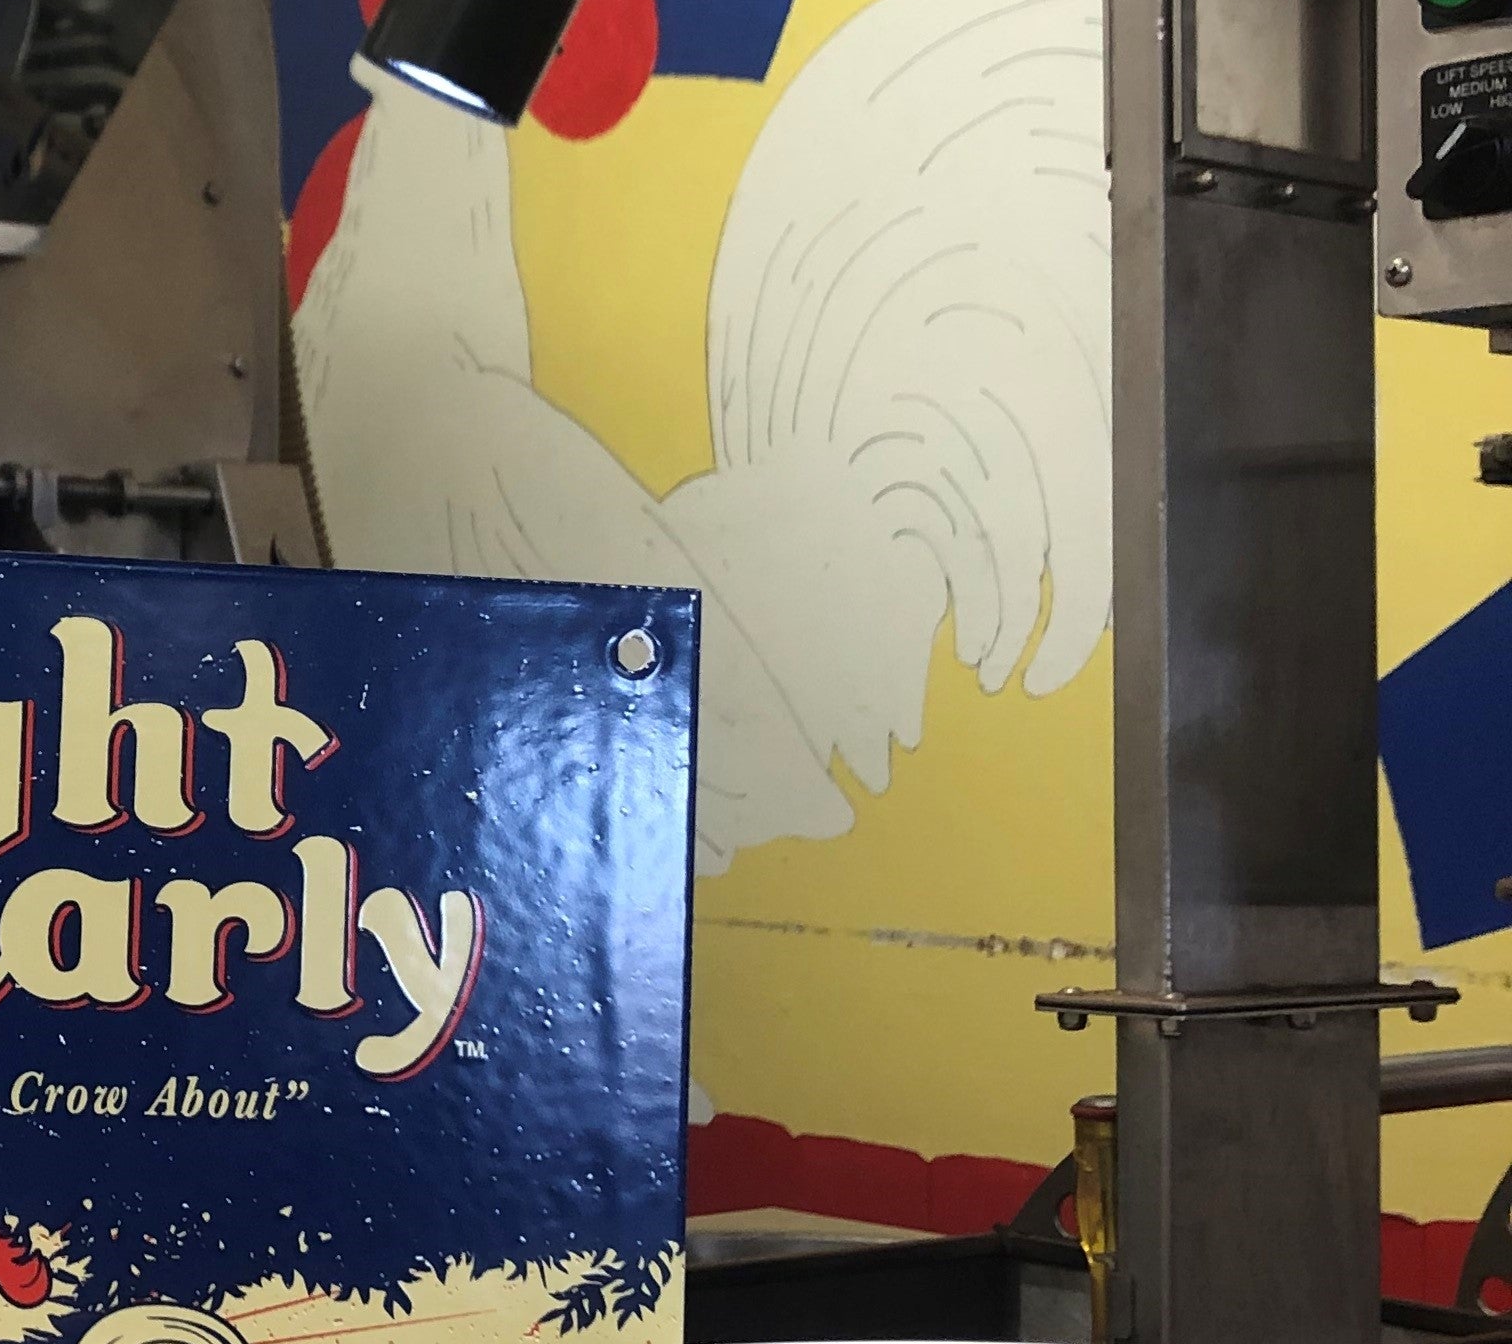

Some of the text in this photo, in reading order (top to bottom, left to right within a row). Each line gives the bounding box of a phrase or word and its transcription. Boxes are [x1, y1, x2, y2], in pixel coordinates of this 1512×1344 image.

[1437, 66, 1465, 85] LIFT
[1448, 77, 1507, 98] MEDIUM
[1430, 100, 1464, 119] LOW
[10, 1071, 129, 1117] Crow
